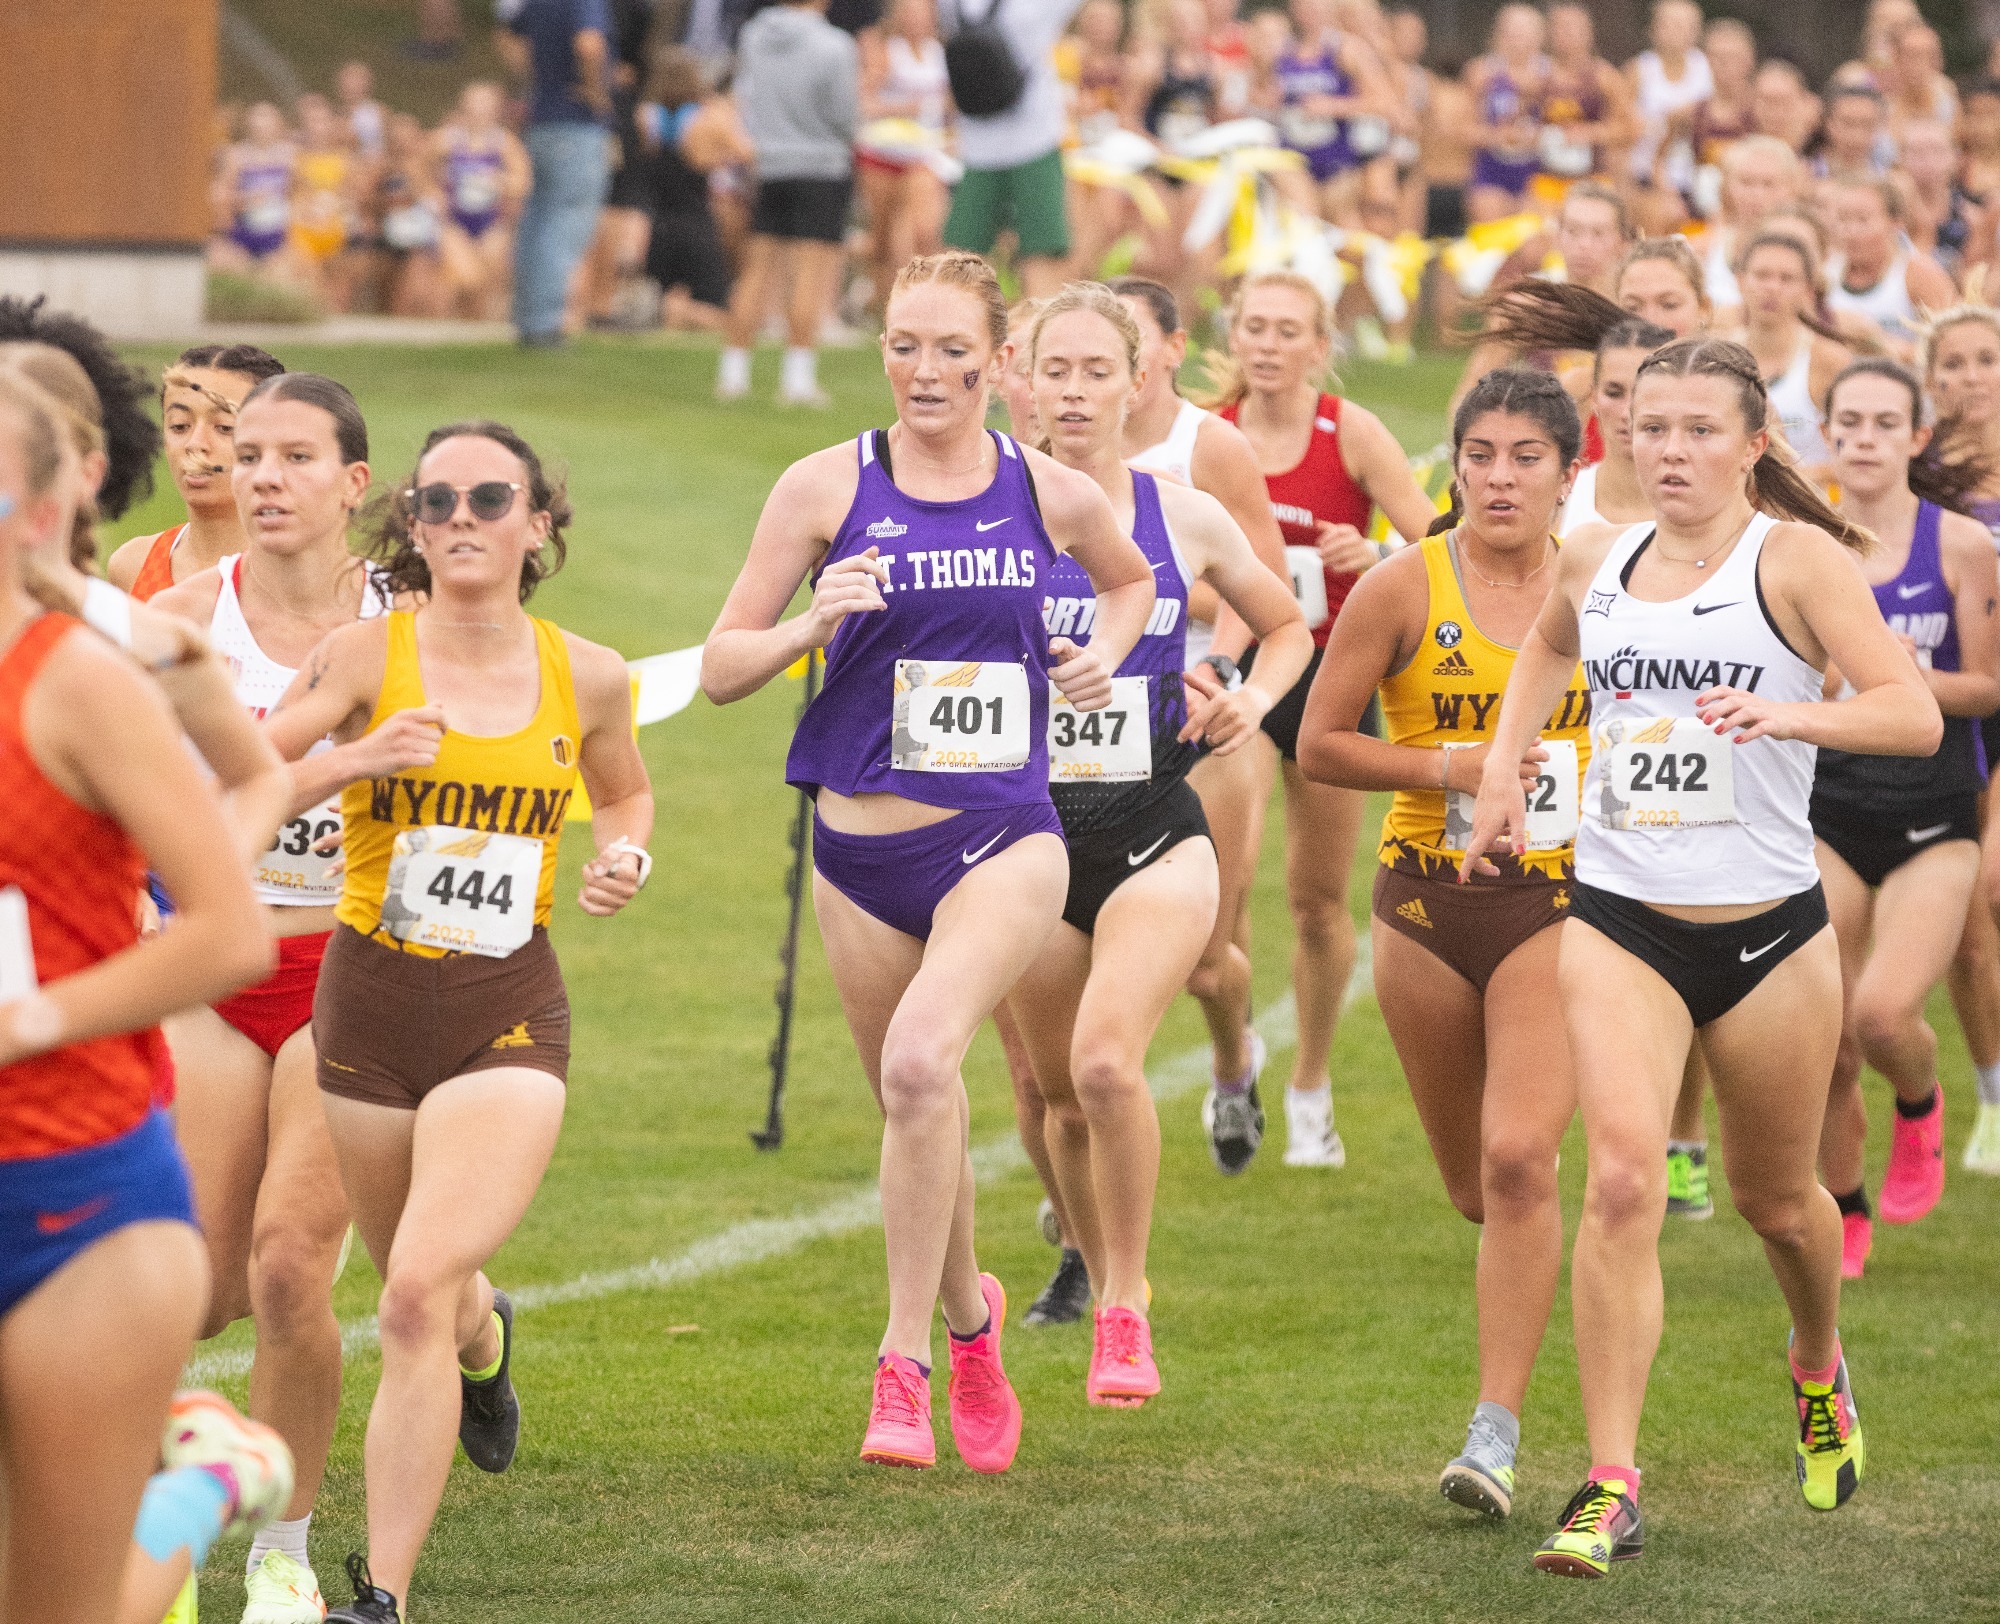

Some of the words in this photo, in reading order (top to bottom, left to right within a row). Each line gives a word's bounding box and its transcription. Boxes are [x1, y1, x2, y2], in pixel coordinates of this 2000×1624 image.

[868, 526, 906, 535] SUMMIT
[1584, 656, 1766, 694] INCINNATI
[929, 695, 1003, 735] 401
[1054, 711, 1127, 748] 347
[935, 751, 979, 766] 2023
[975, 761, 1024, 769] INVITATIONA
[1062, 763, 1103, 776] 2023
[1630, 752, 1708, 792] 242
[1636, 810, 1680, 825] 2023
[258, 867, 305, 887] 2023
[426, 866, 513, 915] 444
[428, 923, 476, 945] 2023
